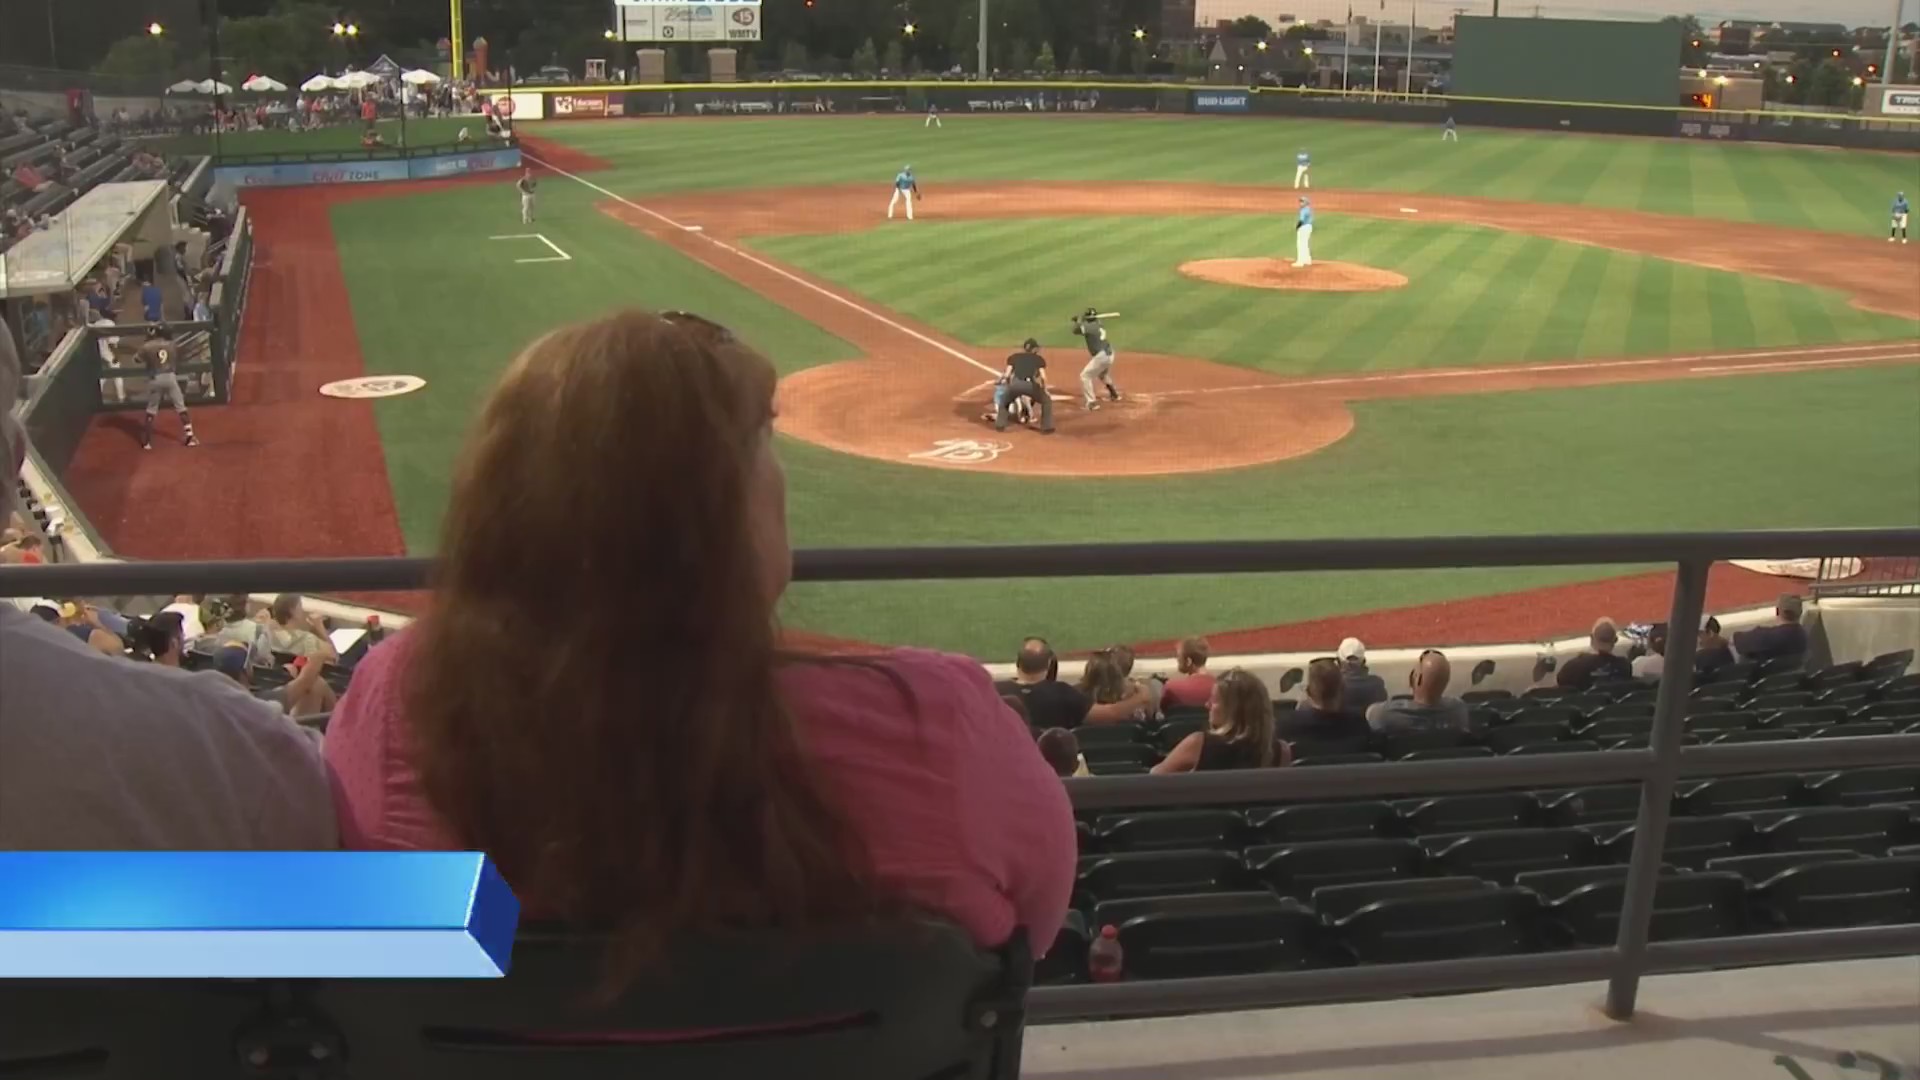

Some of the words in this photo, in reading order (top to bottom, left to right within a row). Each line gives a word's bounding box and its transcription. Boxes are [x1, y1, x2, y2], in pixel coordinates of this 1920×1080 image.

[1198, 96, 1217, 106] BUD
[1219, 96, 1246, 106] LIGHT
[349, 169, 379, 180] ZONE
[158, 348, 168, 364] 9
